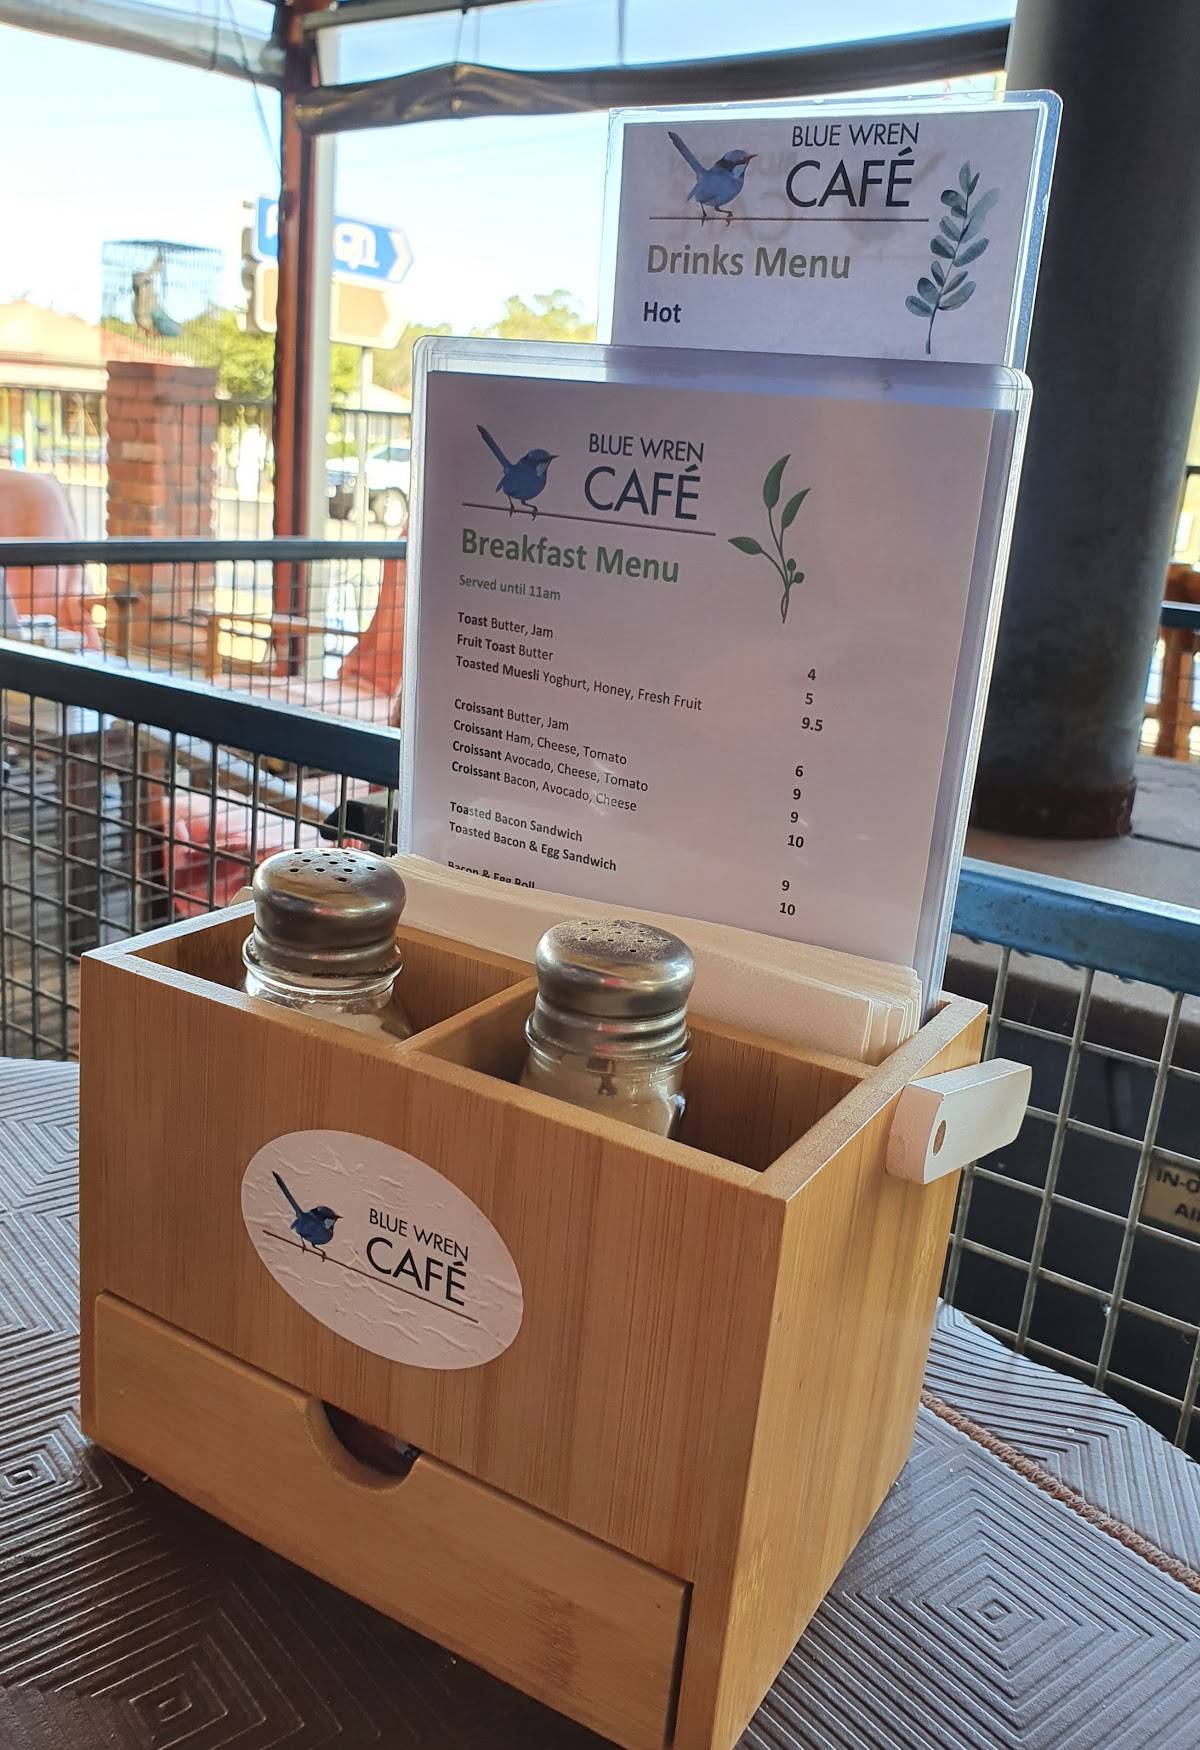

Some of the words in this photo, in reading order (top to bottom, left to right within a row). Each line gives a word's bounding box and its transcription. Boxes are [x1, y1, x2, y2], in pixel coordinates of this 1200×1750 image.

[791, 124, 841, 148] BLUE
[849, 122, 919, 146] WREN
[785, 147, 915, 208] CAFÉ
[647, 244, 744, 276] Drinks
[755, 246, 851, 279] Menu
[643, 301, 682, 323] Hot
[589, 433, 634, 457] BLUE
[640, 437, 704, 463] WREN
[584, 464, 701, 520] CAFÉ
[461, 528, 587, 572] Breakfast
[596, 546, 679, 583] Menu
[459, 574, 497, 591] Served
[500, 579, 526, 596] until
[529, 584, 561, 601] 11am
[457, 612, 488, 627] Toast
[491, 617, 528, 635] Butter,
[531, 624, 553, 638] Jam
[457, 634, 482, 649] Fruit
[485, 639, 515, 654] Toast
[518, 645, 553, 661] Butter
[456, 655, 499, 674] Toasted
[502, 664, 540, 681] Muesli
[543, 671, 590, 692] Yoghurt,
[593, 681, 634, 700] Honey,
[638, 689, 670, 705] Fresh
[674, 695, 702, 711] Fruit
[807, 668, 816, 681] 4
[804, 692, 814, 705] 5
[454, 698, 504, 718] Croissant
[507, 709, 544, 728] Butter,
[547, 716, 569, 731] Jam
[801, 717, 823, 732] 9.5
[453, 719, 503, 740] Croissant
[506, 731, 534, 748] Ham,
[537, 737, 580, 757] Cheese,
[583, 746, 627, 765] Tomato
[452, 740, 502, 761] Croissant
[504, 752, 554, 773] Avocado,
[557, 762, 600, 783] Cheese,
[604, 772, 649, 792] Tomato
[795, 765, 804, 777] 6
[451, 761, 501, 782] Croissant
[503, 773, 539, 791] Bacon,
[542, 781, 592, 803] Avocado,
[595, 793, 637, 812] Cheese
[792, 788, 801, 800] 9
[450, 801, 492, 821] Toasted
[495, 812, 527, 830] Bacon
[530, 820, 583, 842] Sandwich
[790, 811, 799, 824] 9
[449, 821, 491, 841] Toasted
[494, 832, 526, 850] Bacon
[529, 840, 538, 852] &
[541, 843, 560, 860] Egg
[562, 849, 617, 872] Sandwich
[787, 835, 804, 848] 10
[781, 880, 790, 891] 9
[779, 902, 795, 916] 10
[370, 1208, 408, 1237] BLUE
[413, 1224, 469, 1262] WREN
[366, 1237, 467, 1306] CAFÉ
